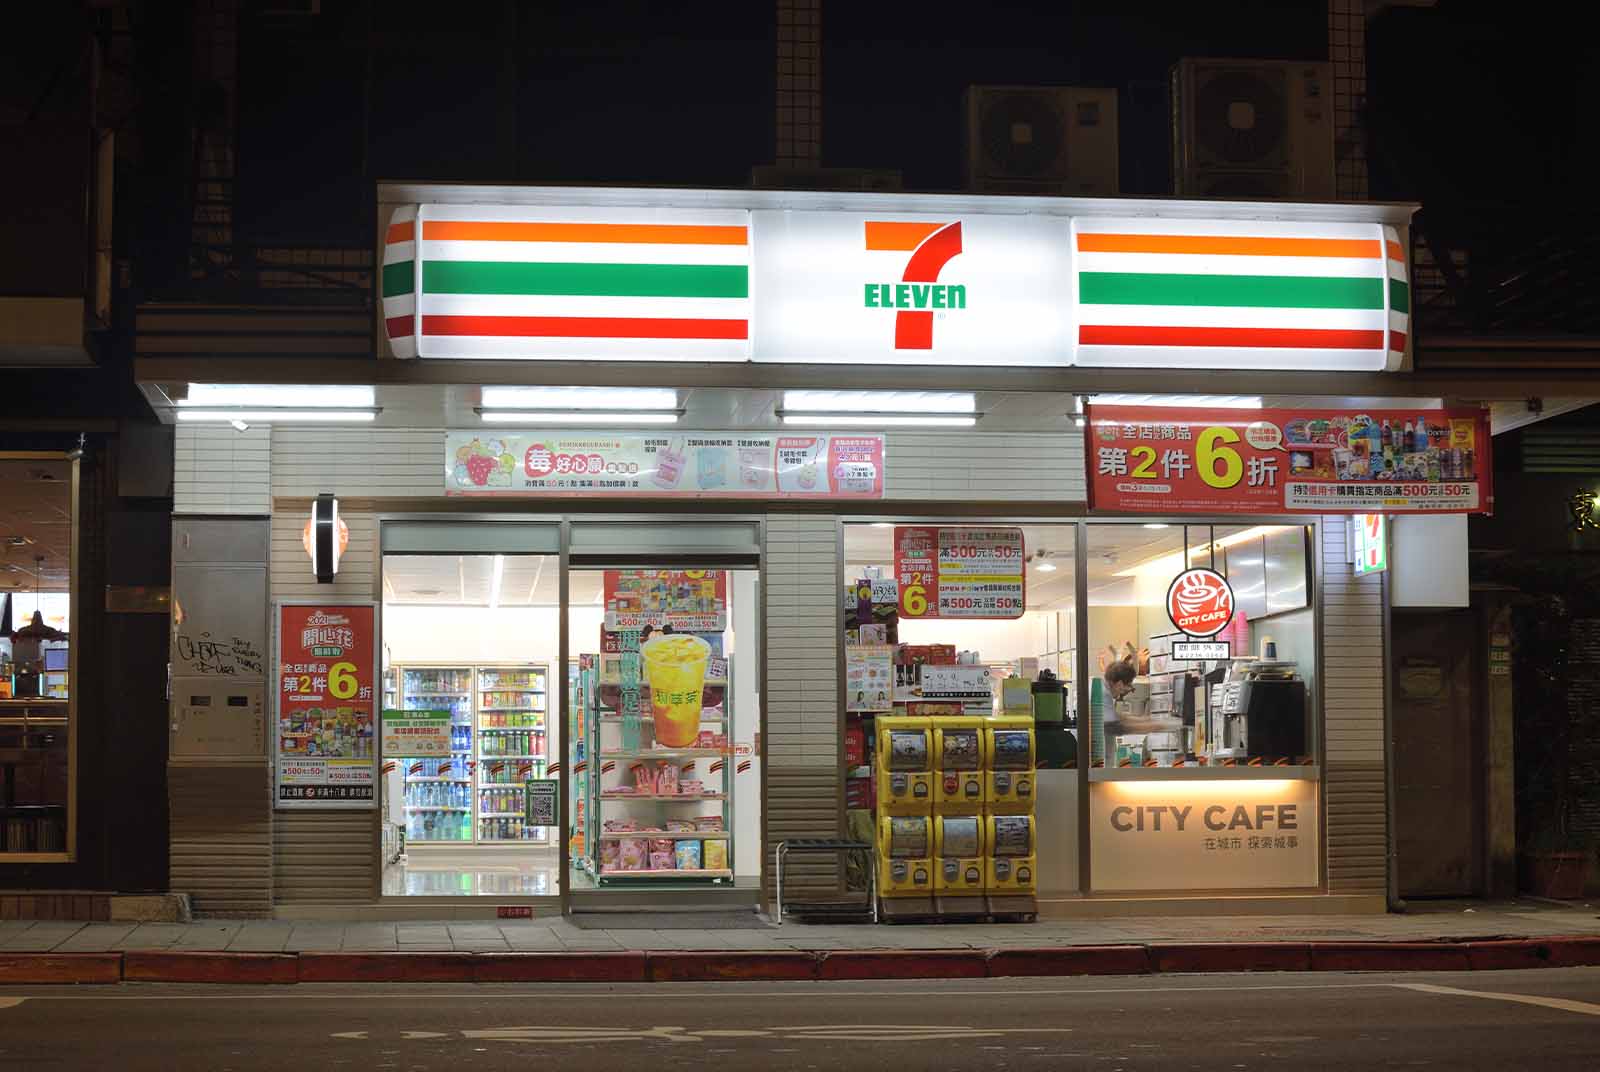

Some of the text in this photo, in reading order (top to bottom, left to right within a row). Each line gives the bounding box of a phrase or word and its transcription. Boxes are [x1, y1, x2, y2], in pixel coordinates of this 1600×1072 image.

[864, 220, 962, 349] 7
[1178, 610, 1226, 626] CITY CAFE
[1110, 805, 1298, 832] CITY CAFE
[1204, 836, 1242, 850] 在城市
